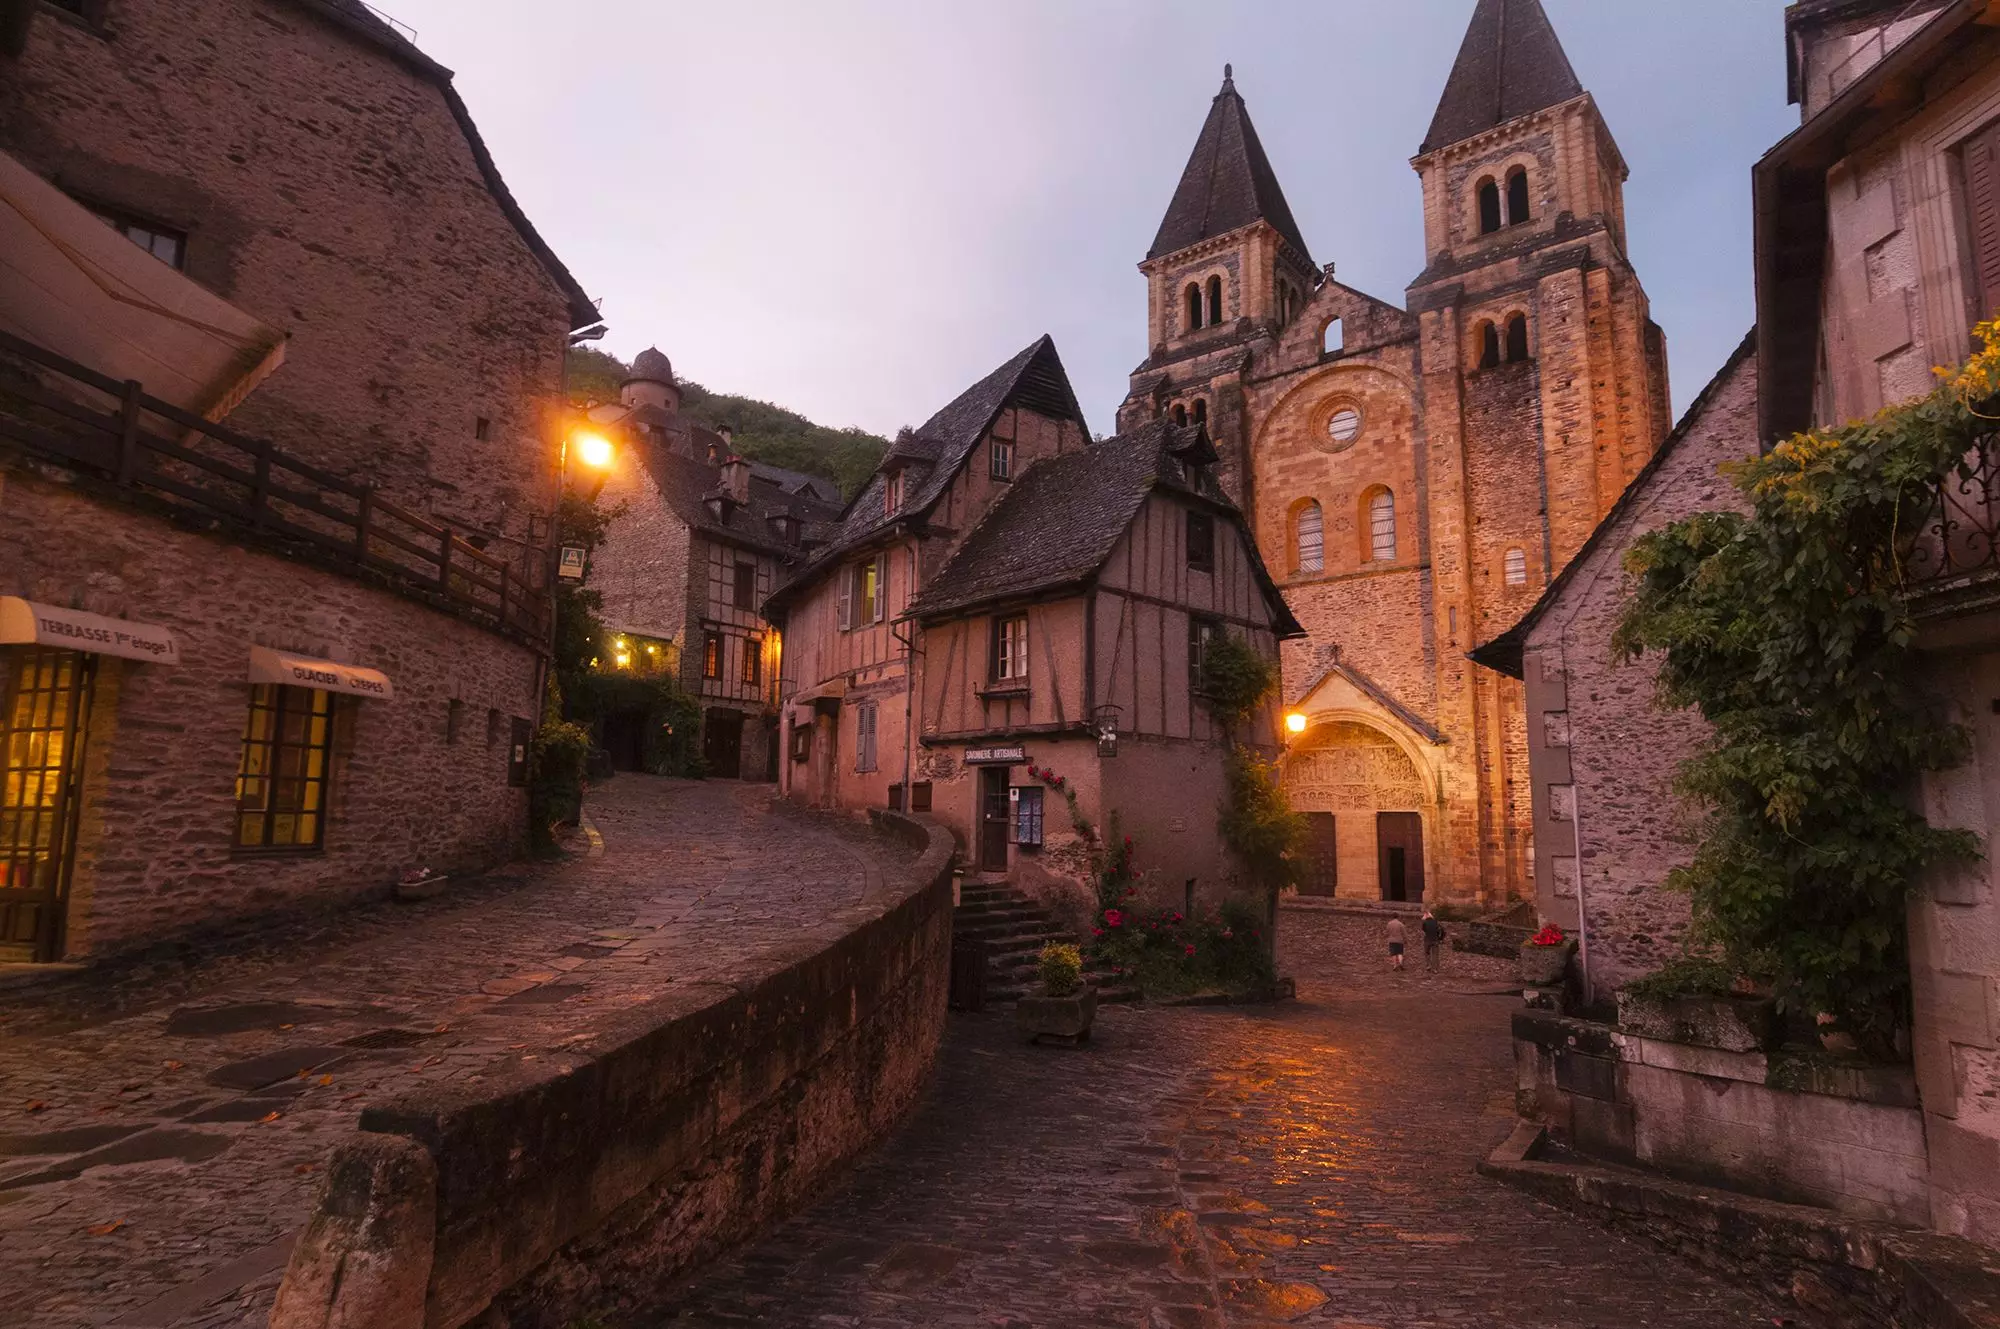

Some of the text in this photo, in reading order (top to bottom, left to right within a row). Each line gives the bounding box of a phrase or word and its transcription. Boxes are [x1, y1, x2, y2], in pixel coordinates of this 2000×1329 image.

[40, 618, 111, 643] TERRASSE
[132, 635, 167, 655] étage
[293, 667, 340, 685] GLACIER
[994, 748, 1022, 758] ARTISANALE
